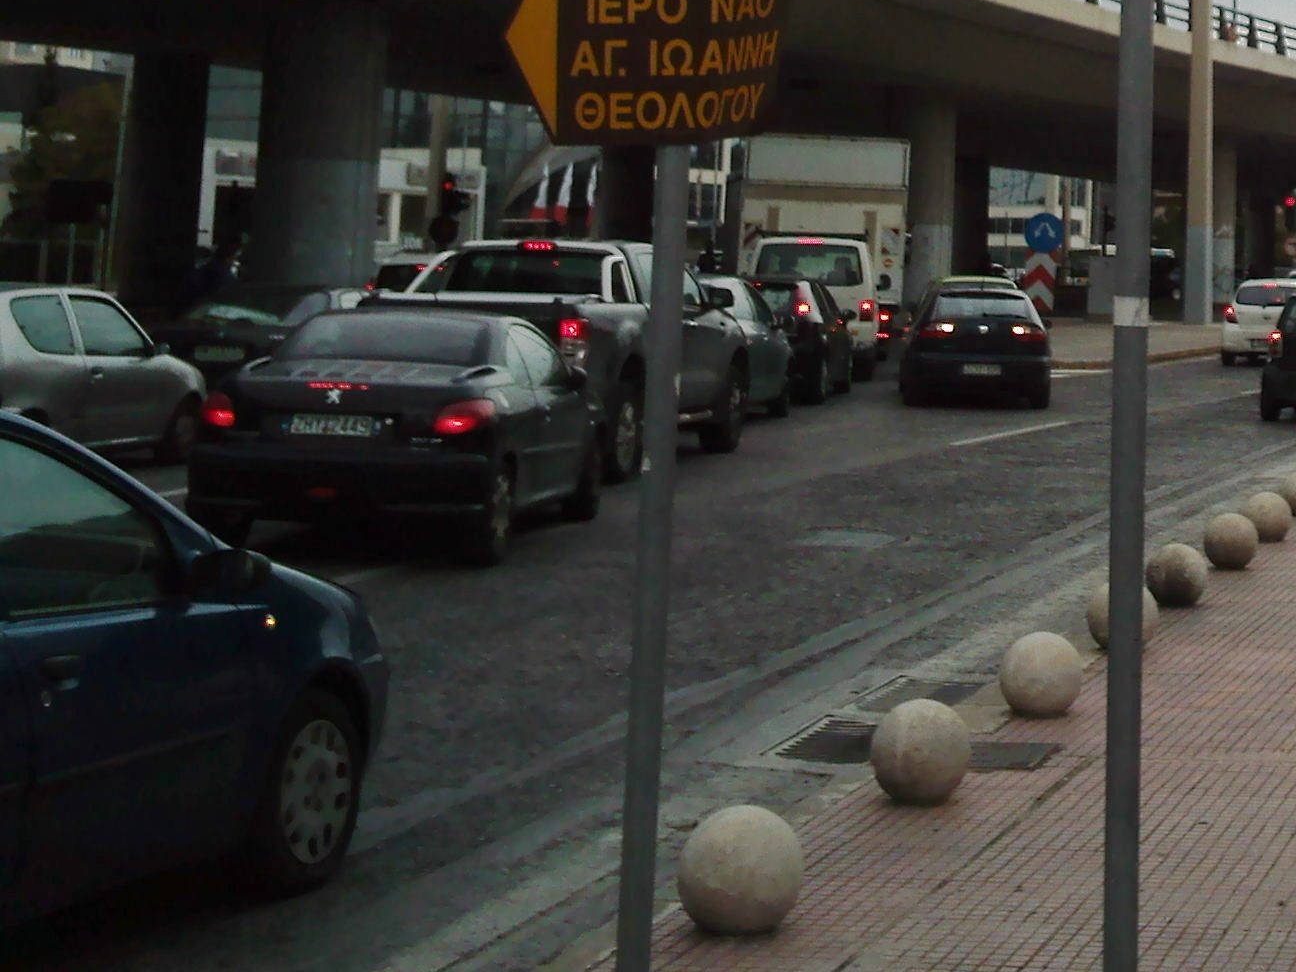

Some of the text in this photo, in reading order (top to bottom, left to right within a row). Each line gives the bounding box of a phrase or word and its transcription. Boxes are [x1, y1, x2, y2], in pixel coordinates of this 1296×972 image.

[570, 31, 778, 79] ΑΓ. ΙΩΑΝΝΗ
[573, 83, 766, 131] ΘΕΟΛΟΓΟΥ
